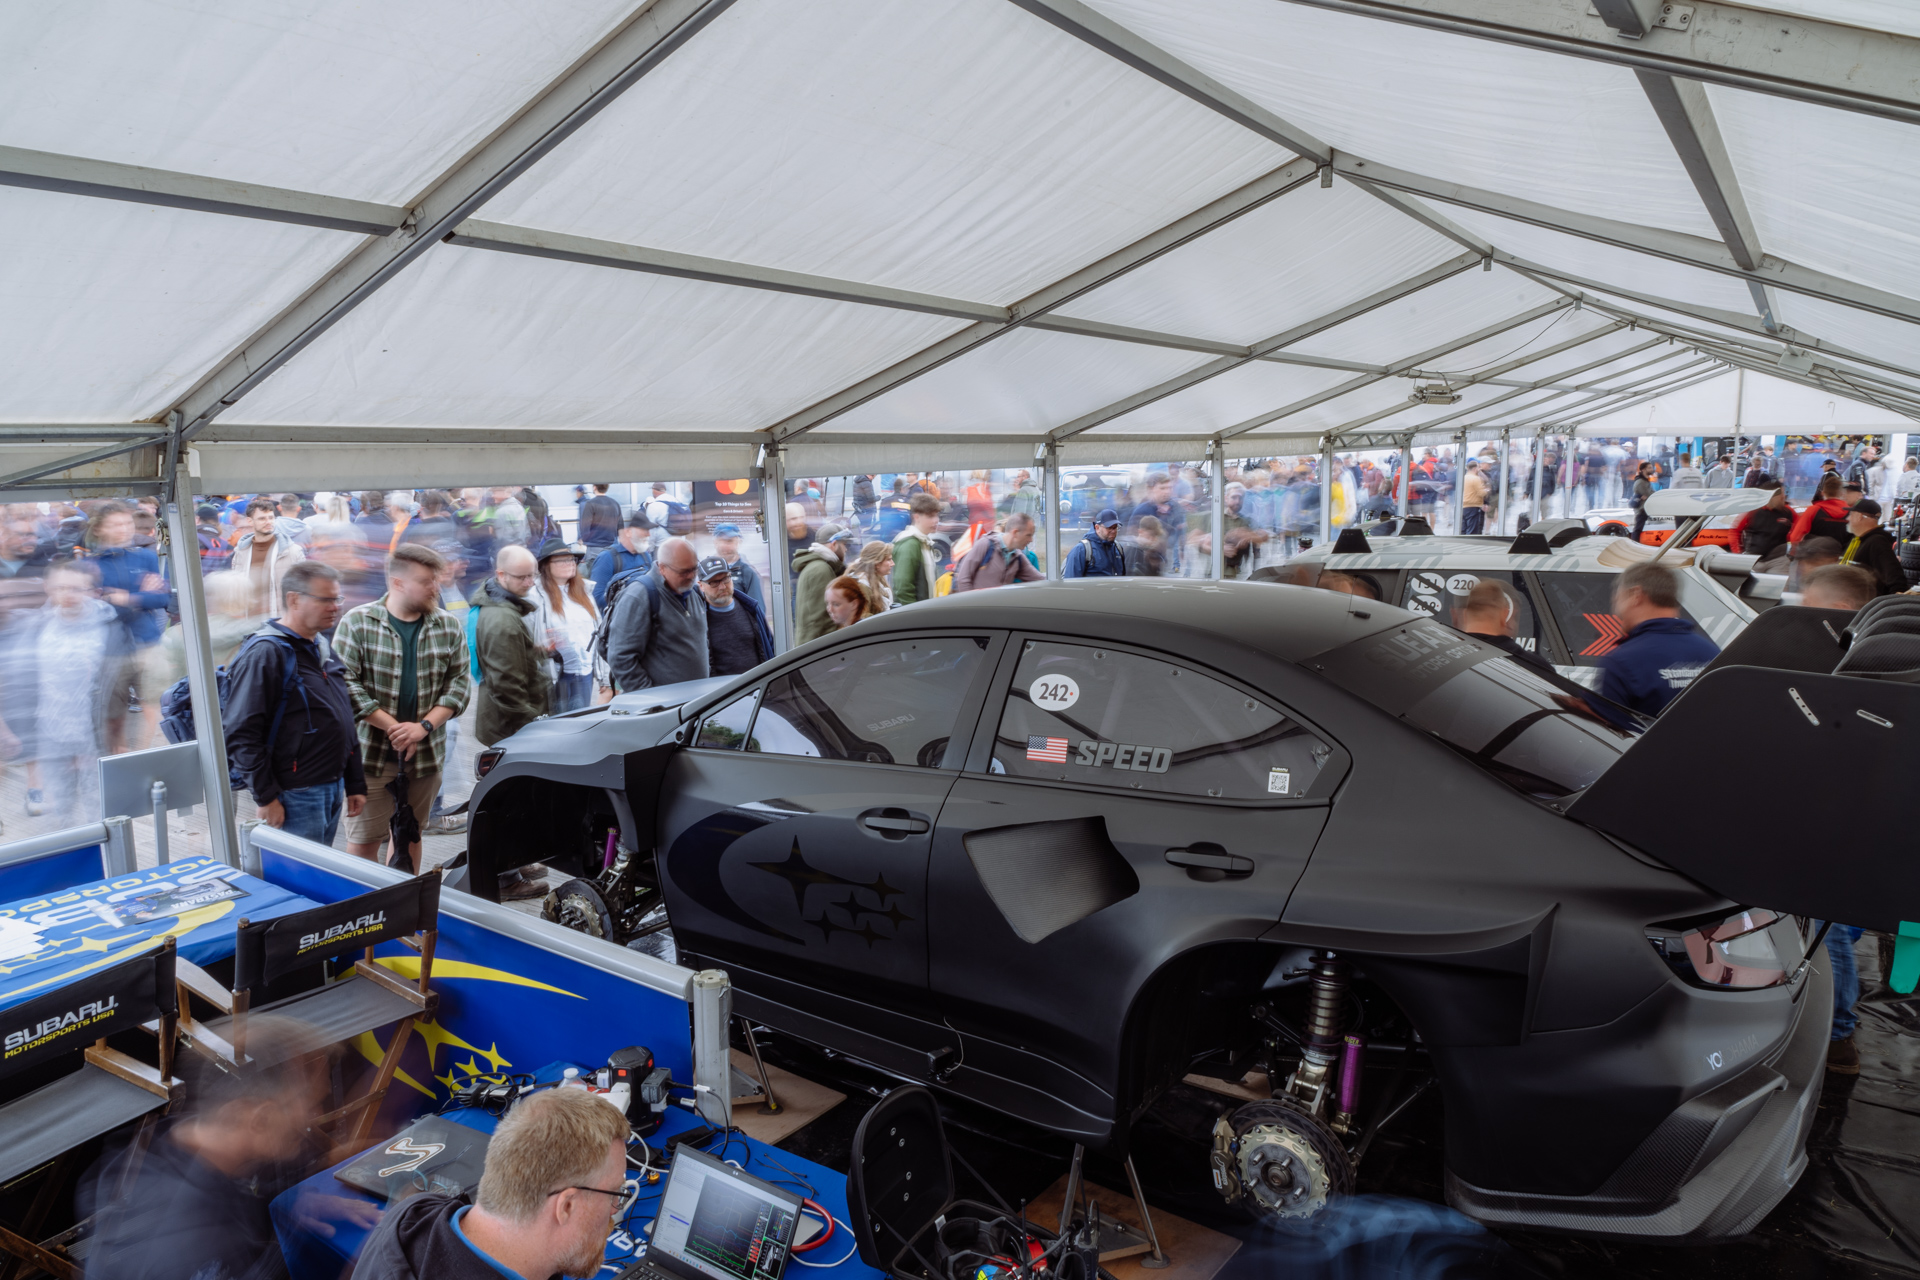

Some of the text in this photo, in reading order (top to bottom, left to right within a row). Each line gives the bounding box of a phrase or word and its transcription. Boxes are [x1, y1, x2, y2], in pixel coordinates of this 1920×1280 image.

[1452, 578, 1474, 590] 220
[1038, 682, 1069, 702] 242
[866, 713, 916, 732] SUBARU
[1074, 740, 1174, 774] SPEED
[297, 923, 384, 956] MOTORSPORTS USA
[4, 1009, 115, 1060] MOTORSPORTS USA
[1705, 1033, 1760, 1071] YOOHAMA
